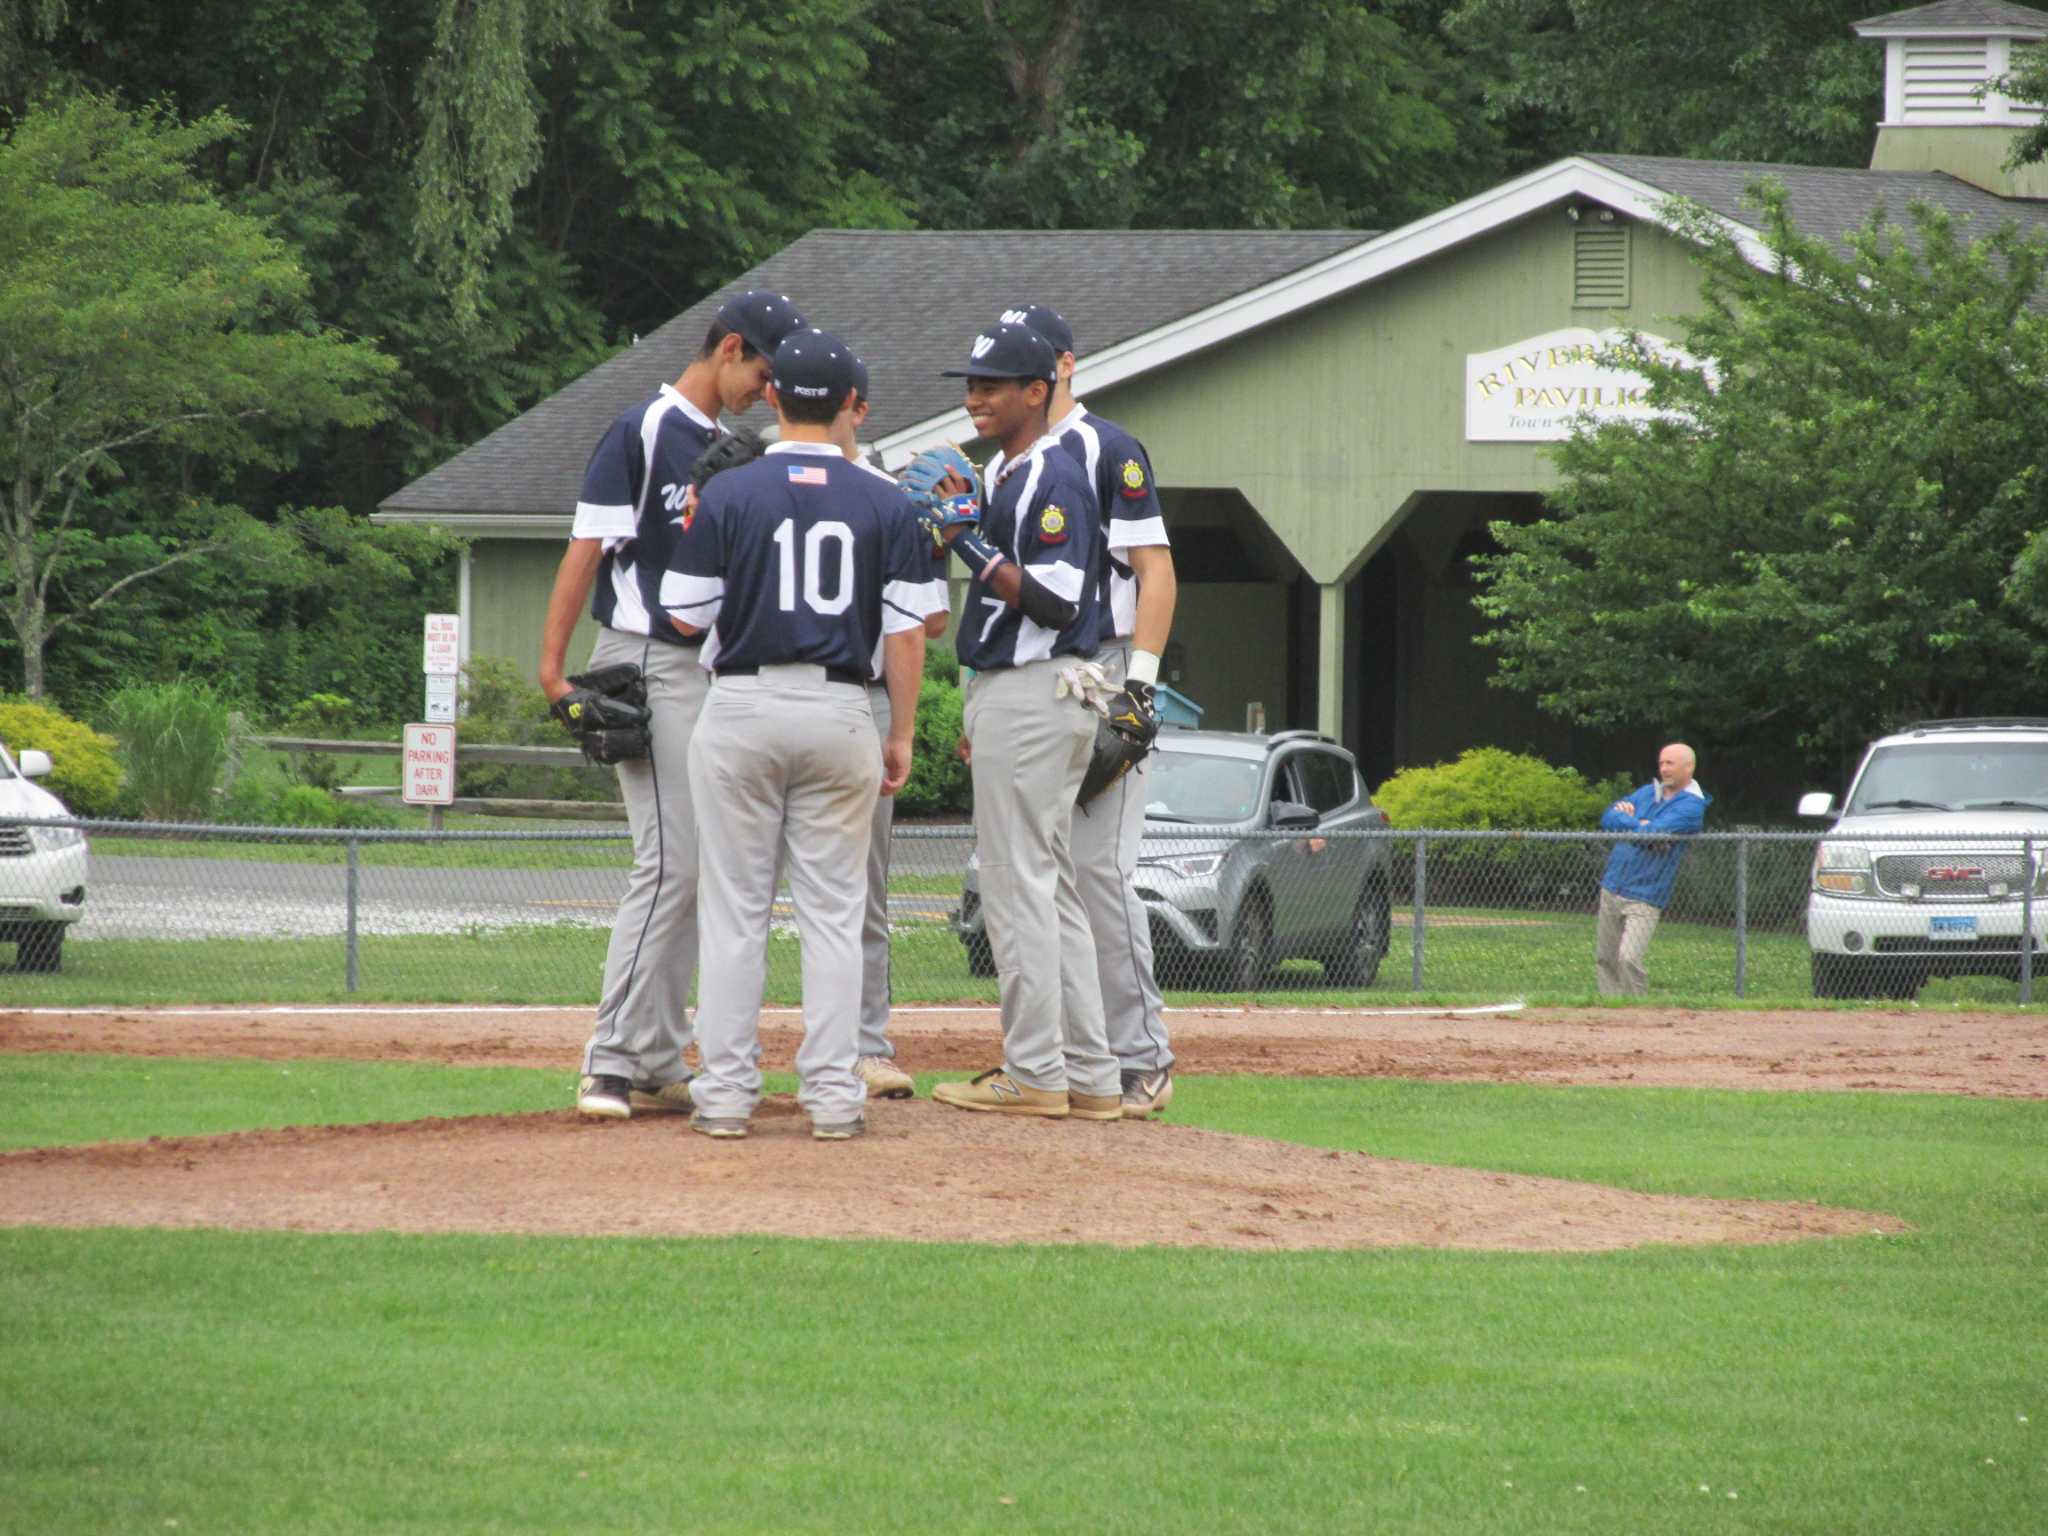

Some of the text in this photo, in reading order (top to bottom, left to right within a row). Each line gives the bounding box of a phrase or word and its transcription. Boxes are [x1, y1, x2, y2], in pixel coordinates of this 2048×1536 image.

[1513, 387, 1653, 409] PAVILIO
[1507, 415, 1553, 429] Town
[773, 518, 855, 616] 10
[979, 597, 1007, 643] 7
[420, 732, 437, 745] NO
[408, 750, 449, 764] PARKING
[414, 767, 443, 781] AFTER
[415, 783, 440, 797] DARK
[1926, 866, 1986, 881] GMC
